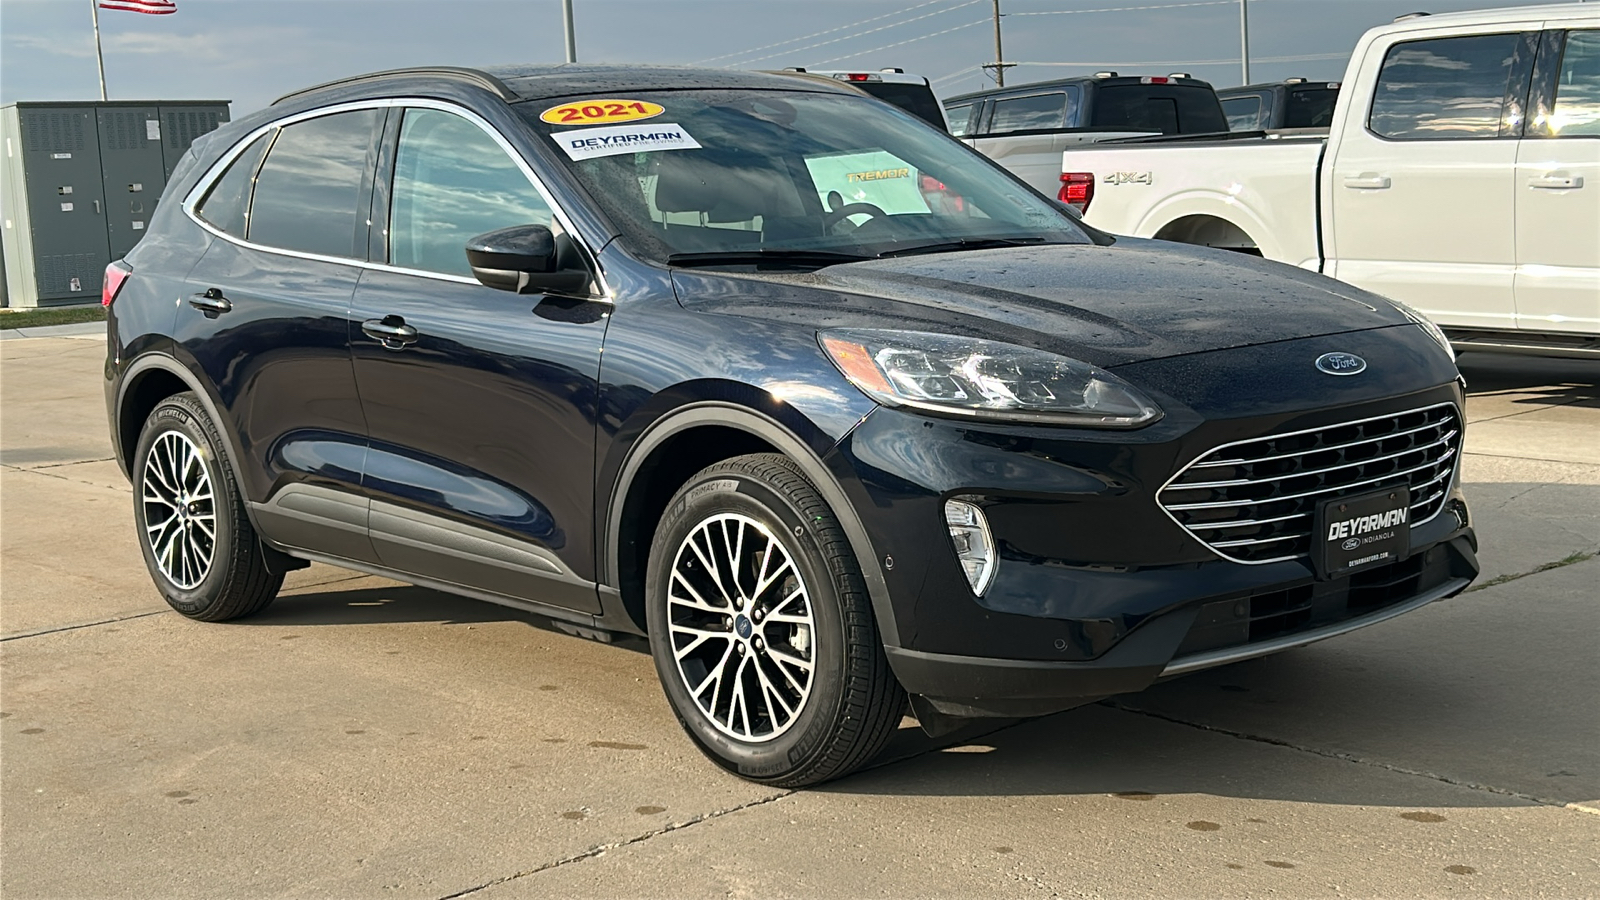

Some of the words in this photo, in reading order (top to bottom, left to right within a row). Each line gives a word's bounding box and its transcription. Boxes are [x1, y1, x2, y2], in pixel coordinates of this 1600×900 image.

[557, 102, 649, 122] 2021
[571, 132, 682, 149] DEYARMAN
[583, 142, 631, 152] CERTIFIED
[633, 138, 685, 147] PRE-OWNED
[846, 168, 910, 183] TREMOR
[158, 409, 187, 423] MICHELIN
[690, 481, 721, 500] PRIMACY
[1327, 507, 1408, 542] DEYARMAN
[1362, 531, 1395, 545] INDIANOLA
